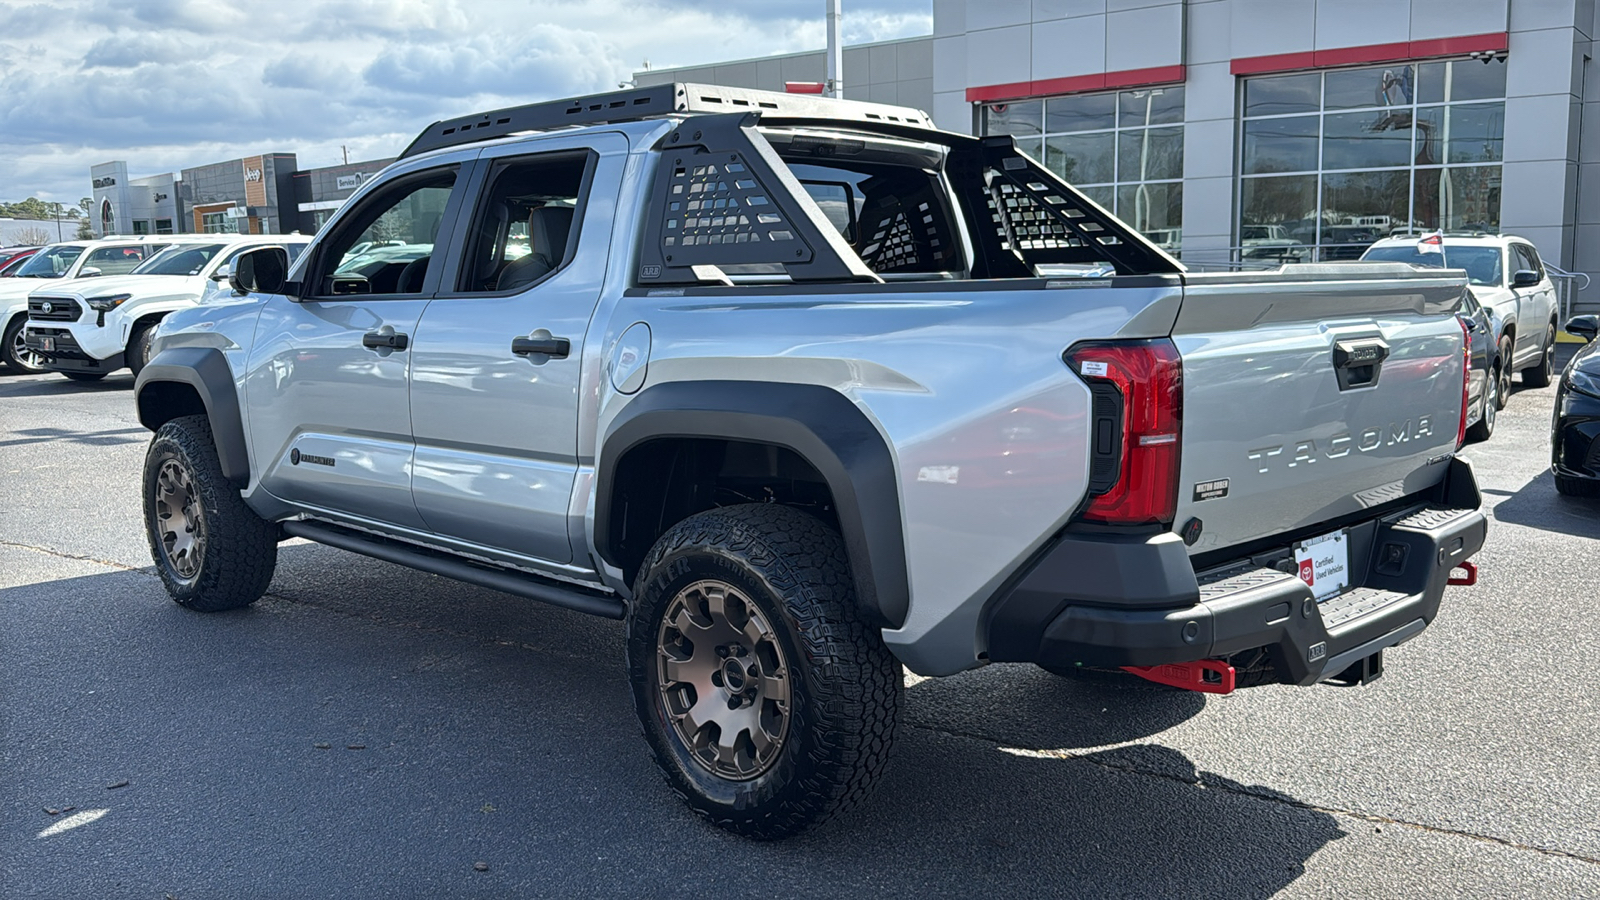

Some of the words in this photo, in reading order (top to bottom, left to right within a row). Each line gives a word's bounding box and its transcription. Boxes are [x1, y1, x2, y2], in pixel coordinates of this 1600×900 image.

[246, 167, 260, 182] Jeep
[643, 267, 659, 275] ARB
[1353, 348, 1377, 360] TOYOTA
[1247, 414, 1434, 473] TACOMA
[1315, 555, 1334, 568] Certified
[1316, 570, 1327, 580] Used
[1327, 564, 1344, 576] Vehicles
[1310, 644, 1325, 659] ARB
